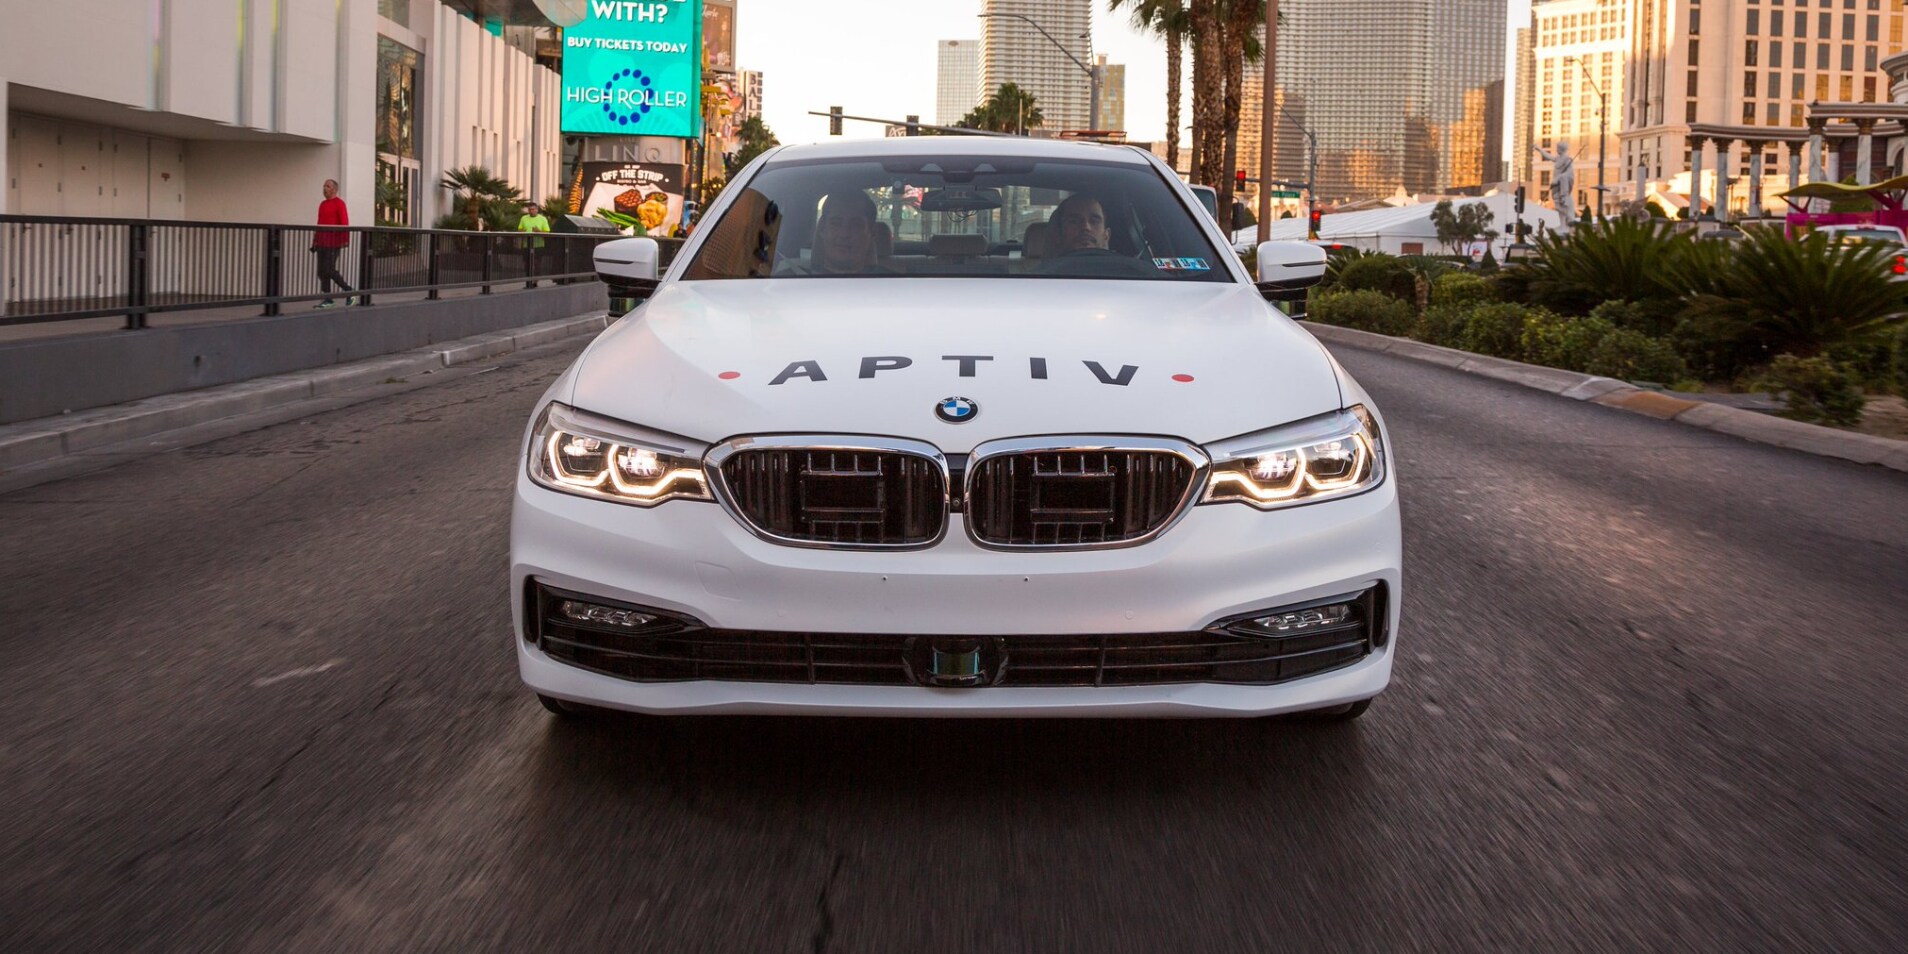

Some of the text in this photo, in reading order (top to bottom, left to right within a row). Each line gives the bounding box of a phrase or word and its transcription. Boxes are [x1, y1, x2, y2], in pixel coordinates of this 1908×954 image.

[590, 0, 669, 23] WITH?
[567, 36, 688, 54] BUY TICKETS TODAY
[566, 86, 687, 110] HIGH ROLLER
[601, 169, 664, 183] OFF THE STRIP
[768, 355, 1139, 387] APTIV
